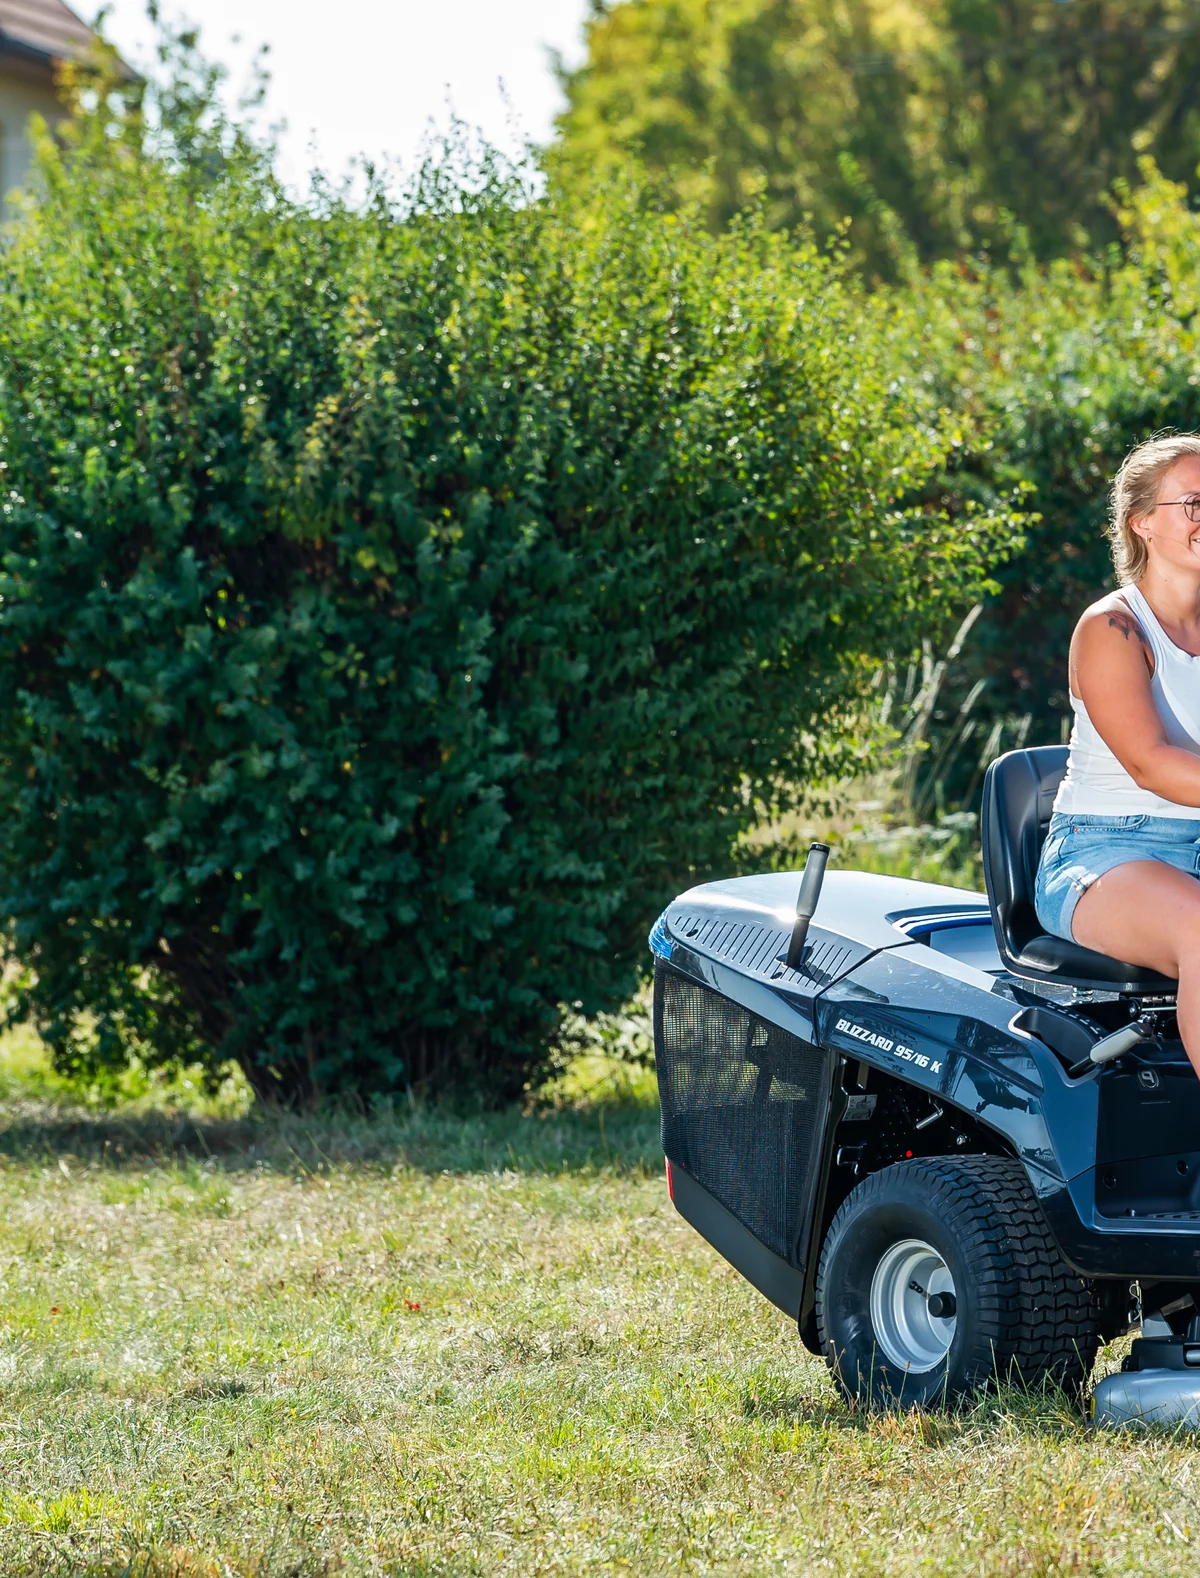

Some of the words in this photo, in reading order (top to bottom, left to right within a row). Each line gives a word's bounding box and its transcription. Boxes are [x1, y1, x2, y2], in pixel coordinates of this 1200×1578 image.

[835, 1018, 894, 1052] BLIZZARD
[893, 1045, 931, 1069] 95/16
[929, 1059, 943, 1074] K
